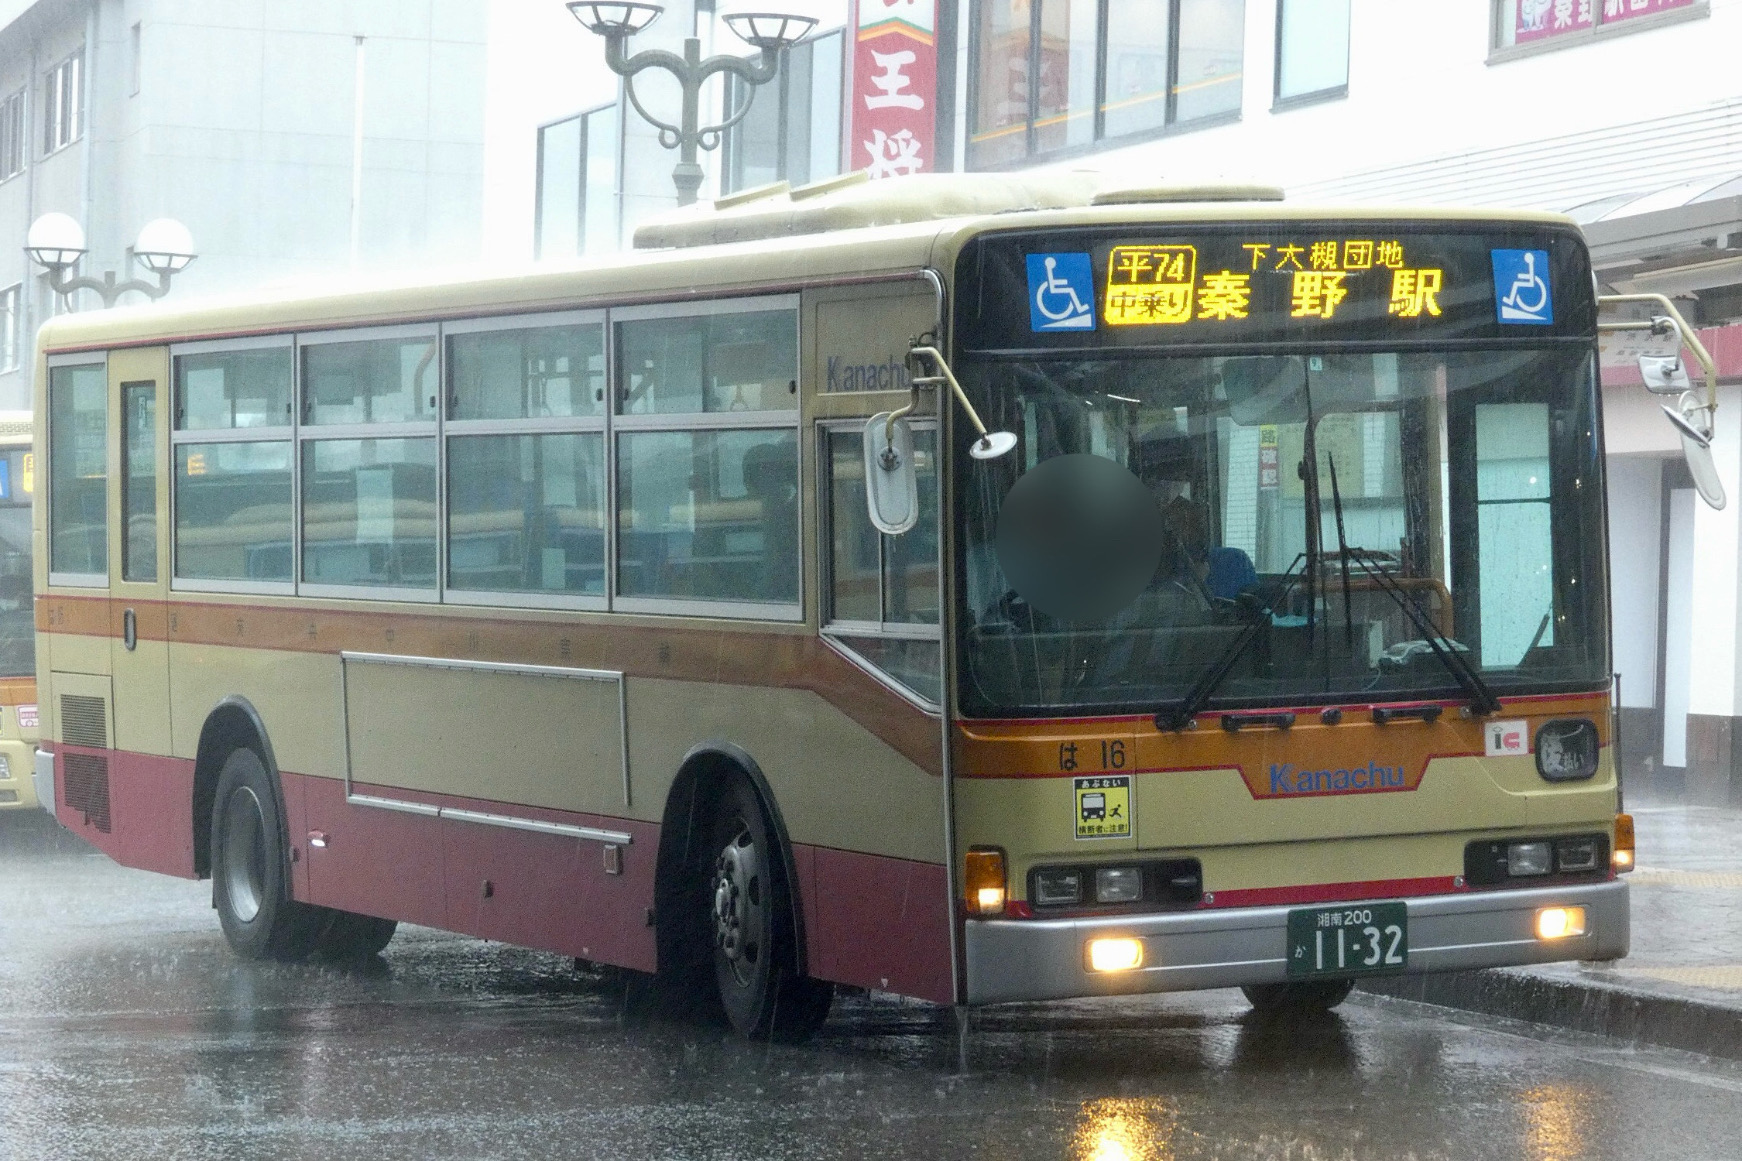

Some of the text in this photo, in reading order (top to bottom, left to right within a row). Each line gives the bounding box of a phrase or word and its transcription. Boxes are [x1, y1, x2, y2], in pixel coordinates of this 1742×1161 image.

[863, 49, 925, 179] 王将
[1117, 250, 1186, 284] 平74
[1242, 240, 1404, 270] 下大槻団地
[1110, 289, 1190, 319] 中乗り
[1197, 269, 1443, 321] 秦野駅
[1060, 740, 1125, 771] は 16
[1082, 780, 1121, 789] あぶない
[1269, 761, 1405, 794] Kanachu
[1316, 925, 1402, 970] 11-32
